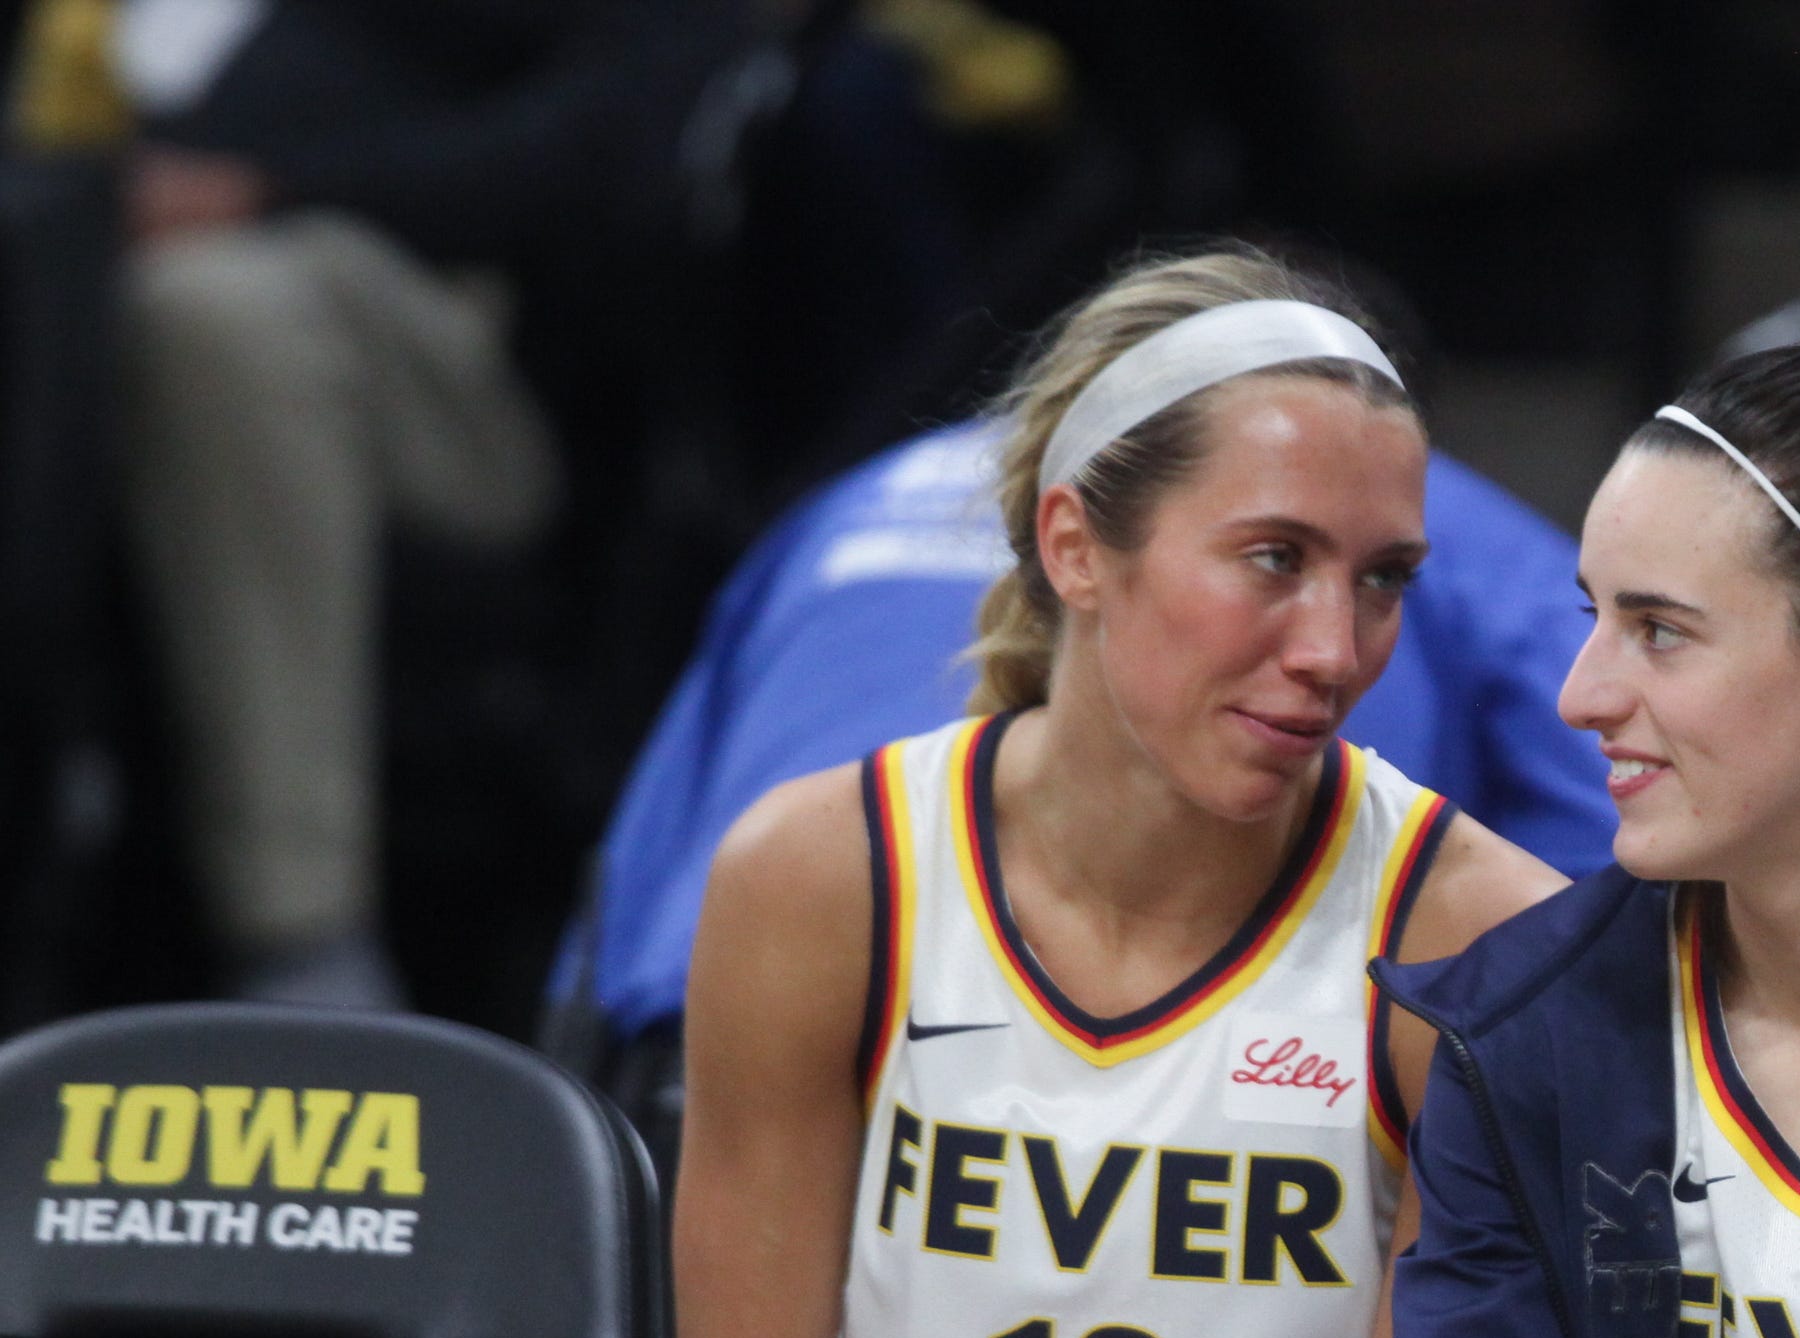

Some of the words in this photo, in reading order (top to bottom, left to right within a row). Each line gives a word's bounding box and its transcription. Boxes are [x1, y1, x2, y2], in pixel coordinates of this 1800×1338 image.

[1232, 1037, 1355, 1107] Lilly
[45, 1083, 426, 1196] IOWA
[36, 1199, 259, 1244] HEALTH
[268, 1203, 419, 1254] CARE
[878, 1102, 1354, 1288] FEVER
